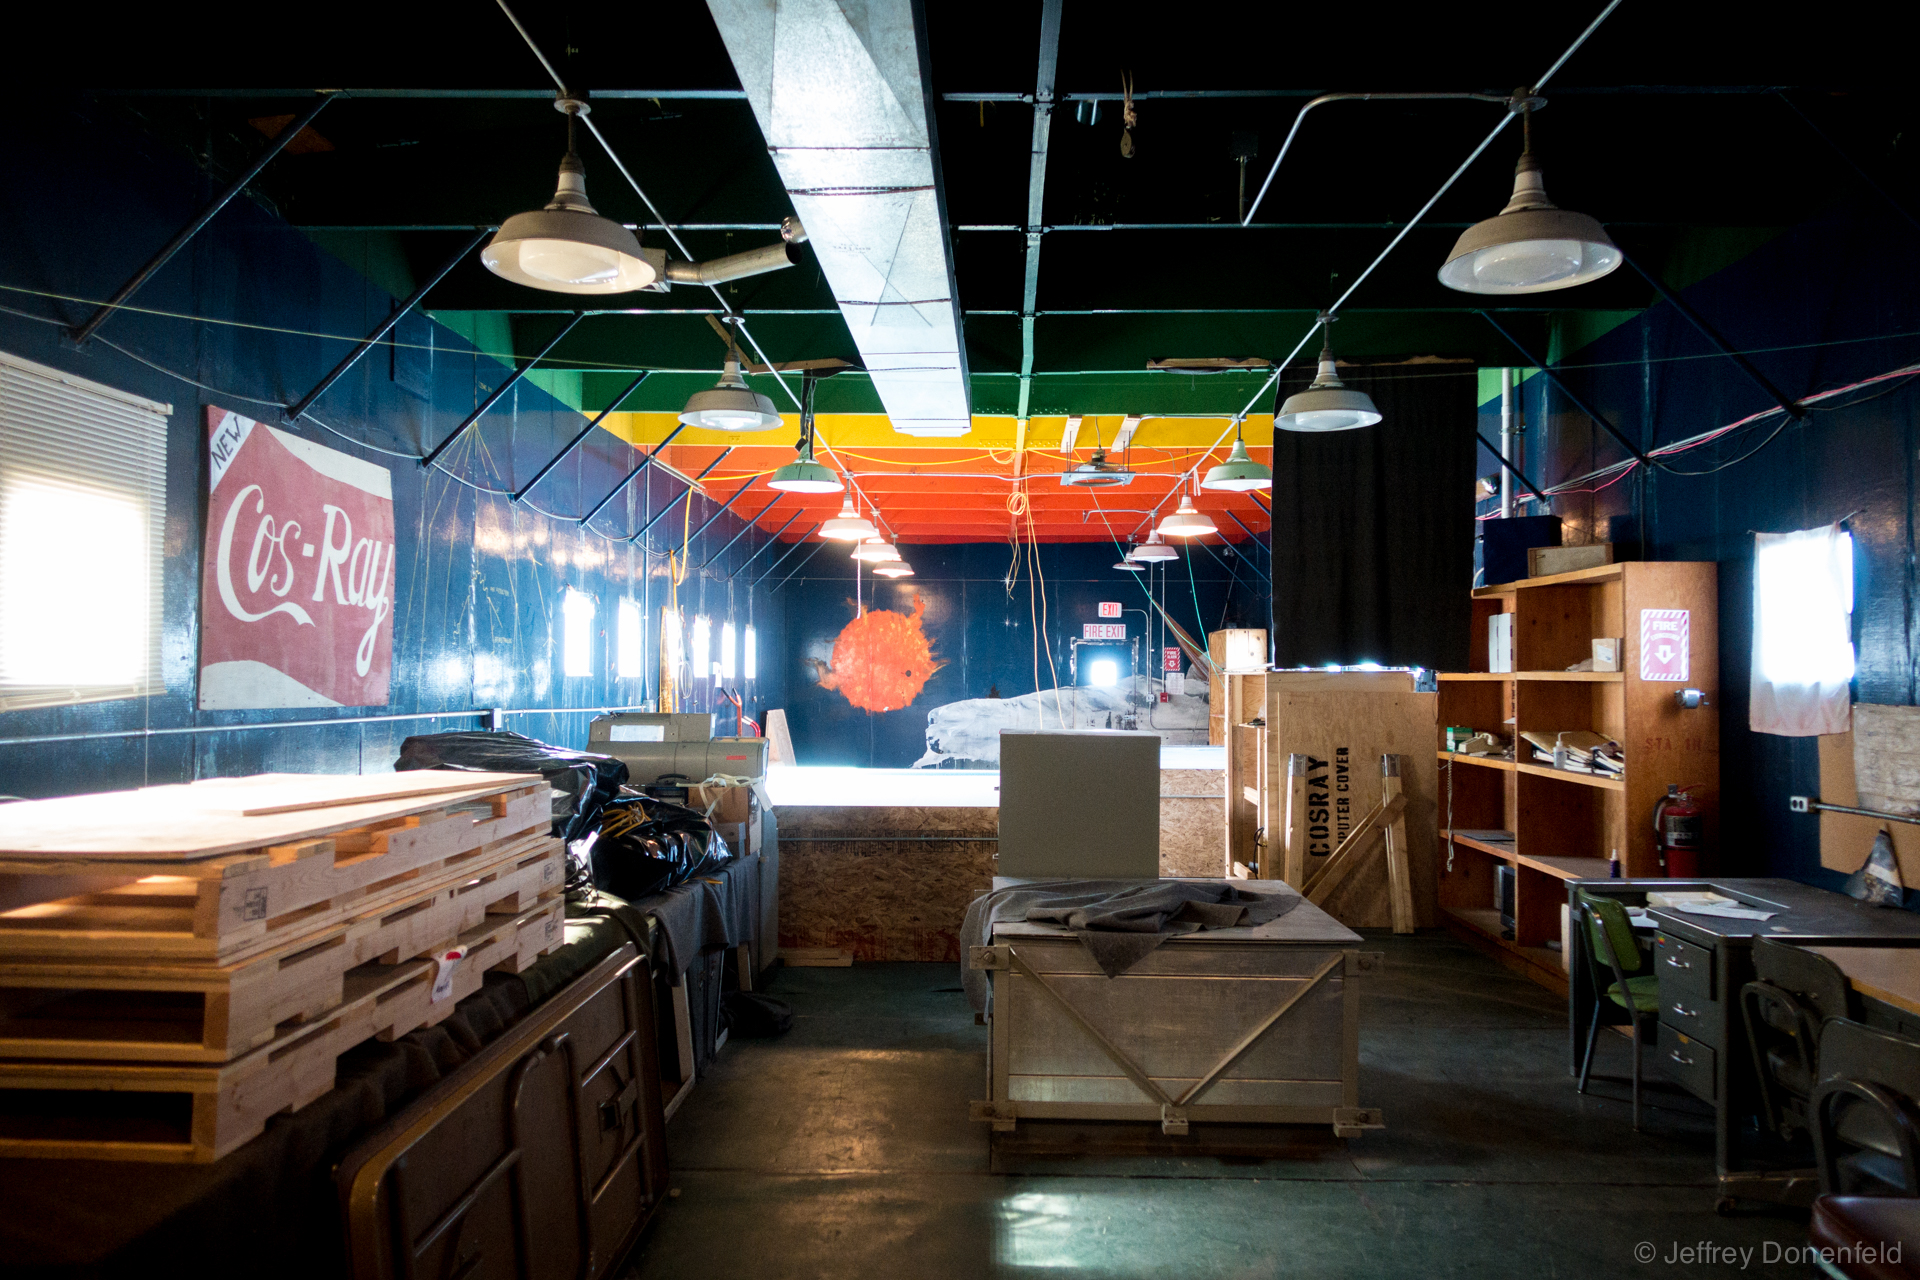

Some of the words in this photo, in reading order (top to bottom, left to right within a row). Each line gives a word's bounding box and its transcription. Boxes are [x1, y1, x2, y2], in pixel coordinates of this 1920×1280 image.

[210, 416, 242, 470] NEW
[216, 484, 395, 678] Cos-Ray
[1102, 603, 1119, 617] EXIT
[1084, 625, 1104, 638] FIRE
[1106, 625, 1125, 638] EXIT
[1652, 620, 1679, 631] FIRE
[1645, 737, 1672, 751] STA
[1336, 747, 1349, 792] COVER
[1307, 756, 1330, 857] COSRAY
